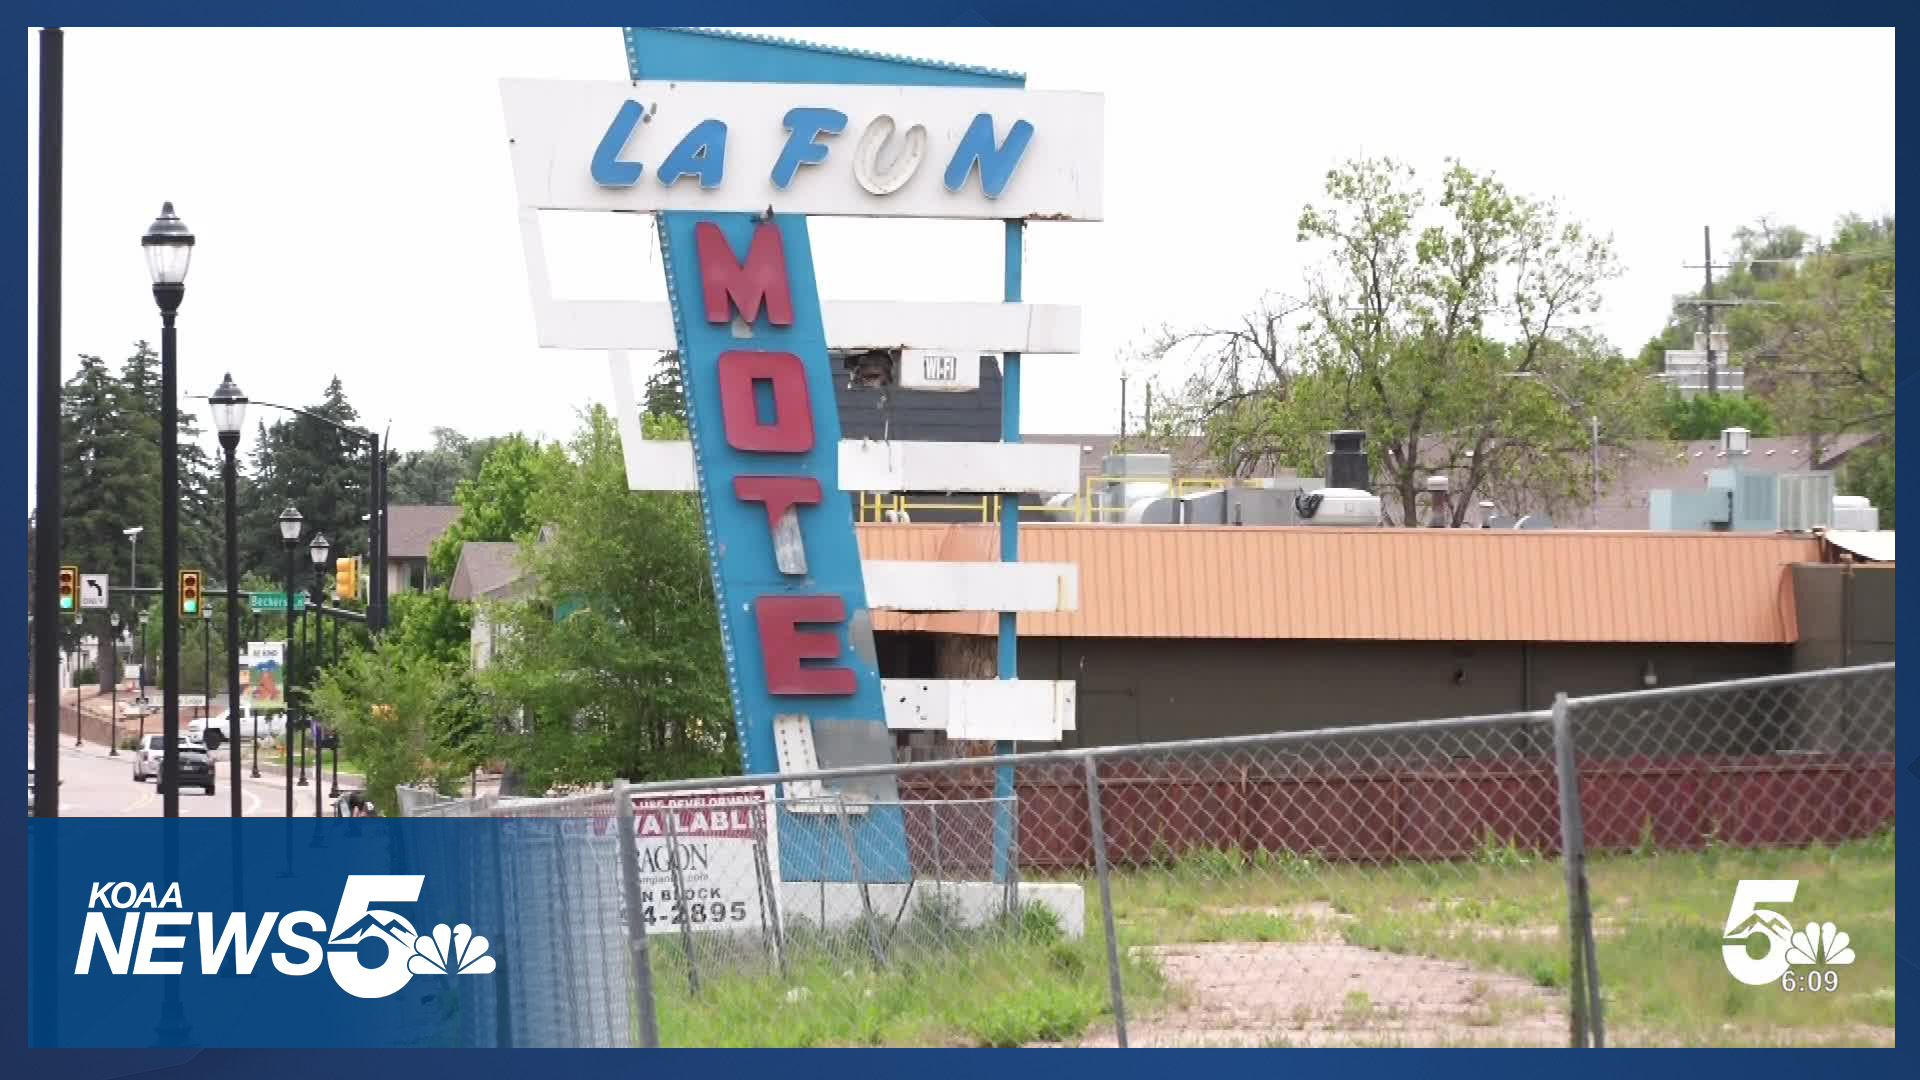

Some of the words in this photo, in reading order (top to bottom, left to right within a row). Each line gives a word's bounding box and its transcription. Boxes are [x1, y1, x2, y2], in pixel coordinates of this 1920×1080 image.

[590, 98, 728, 190] LA
[769, 106, 1036, 201] FUN
[923, 356, 957, 380] WI-FI
